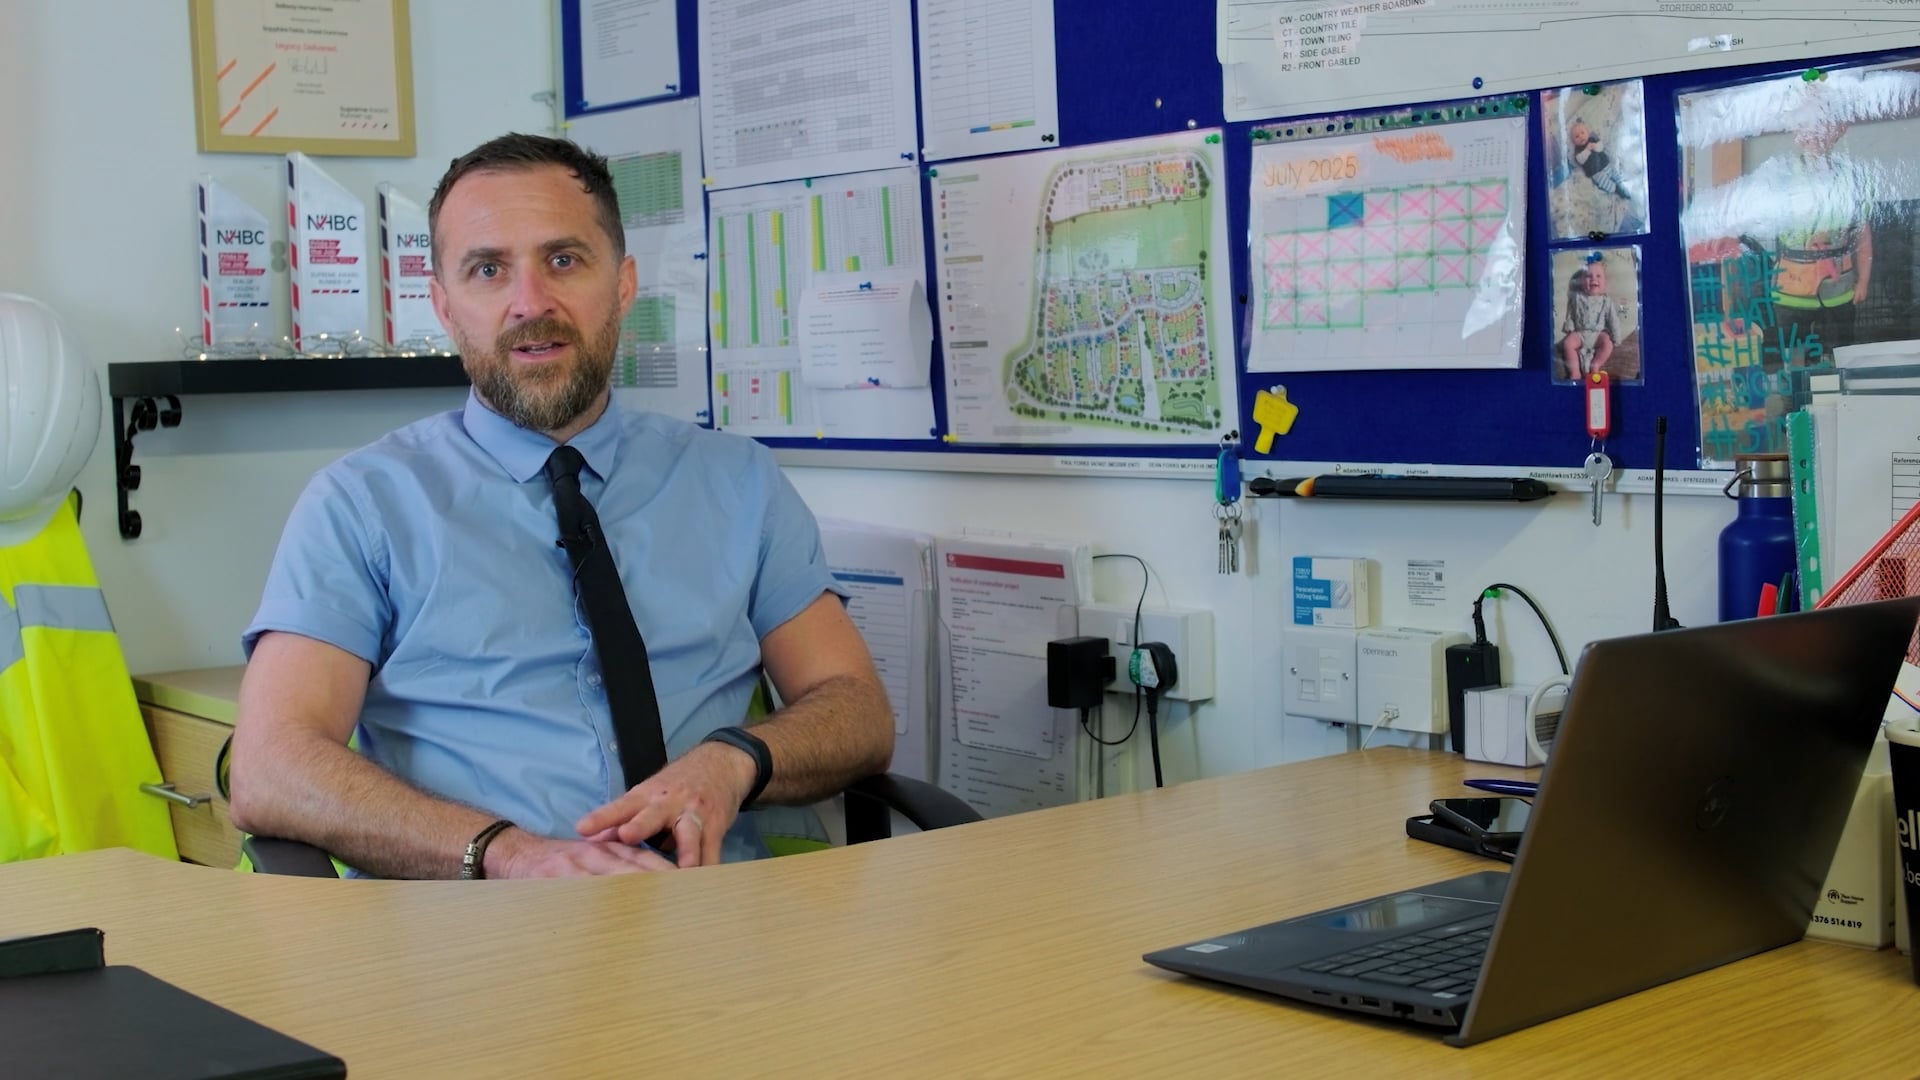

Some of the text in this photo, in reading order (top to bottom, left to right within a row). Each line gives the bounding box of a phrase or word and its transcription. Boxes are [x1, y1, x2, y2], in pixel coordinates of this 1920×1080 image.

[1279, 16, 1292, 25] CW
[1299, 10, 1338, 22] COUNTRY
[1340, 4, 1381, 16] WEATHER
[1659, 3, 1734, 12] STORTFORD ROAD
[1299, 23, 1338, 35] COUNTRY
[1341, 19, 1358, 29] TILE
[1300, 36, 1325, 46] TOWN
[1327, 33, 1351, 43] TILING
[1299, 49, 1318, 58] SIDE
[1321, 45, 1347, 56] GABLE
[1281, 64, 1292, 72] R2
[1298, 60, 1325, 71] FRONT
[1327, 56, 1361, 68] GABLED
[1263, 155, 1356, 191] July 2025
[307, 214, 358, 231] NHBC
[216, 229, 265, 245] NHBC
[397, 233, 431, 248] NHB
[1362, 647, 1398, 657] openreach
[1831, 917, 1846, 927] 514
[1847, 920, 1863, 928] 819
